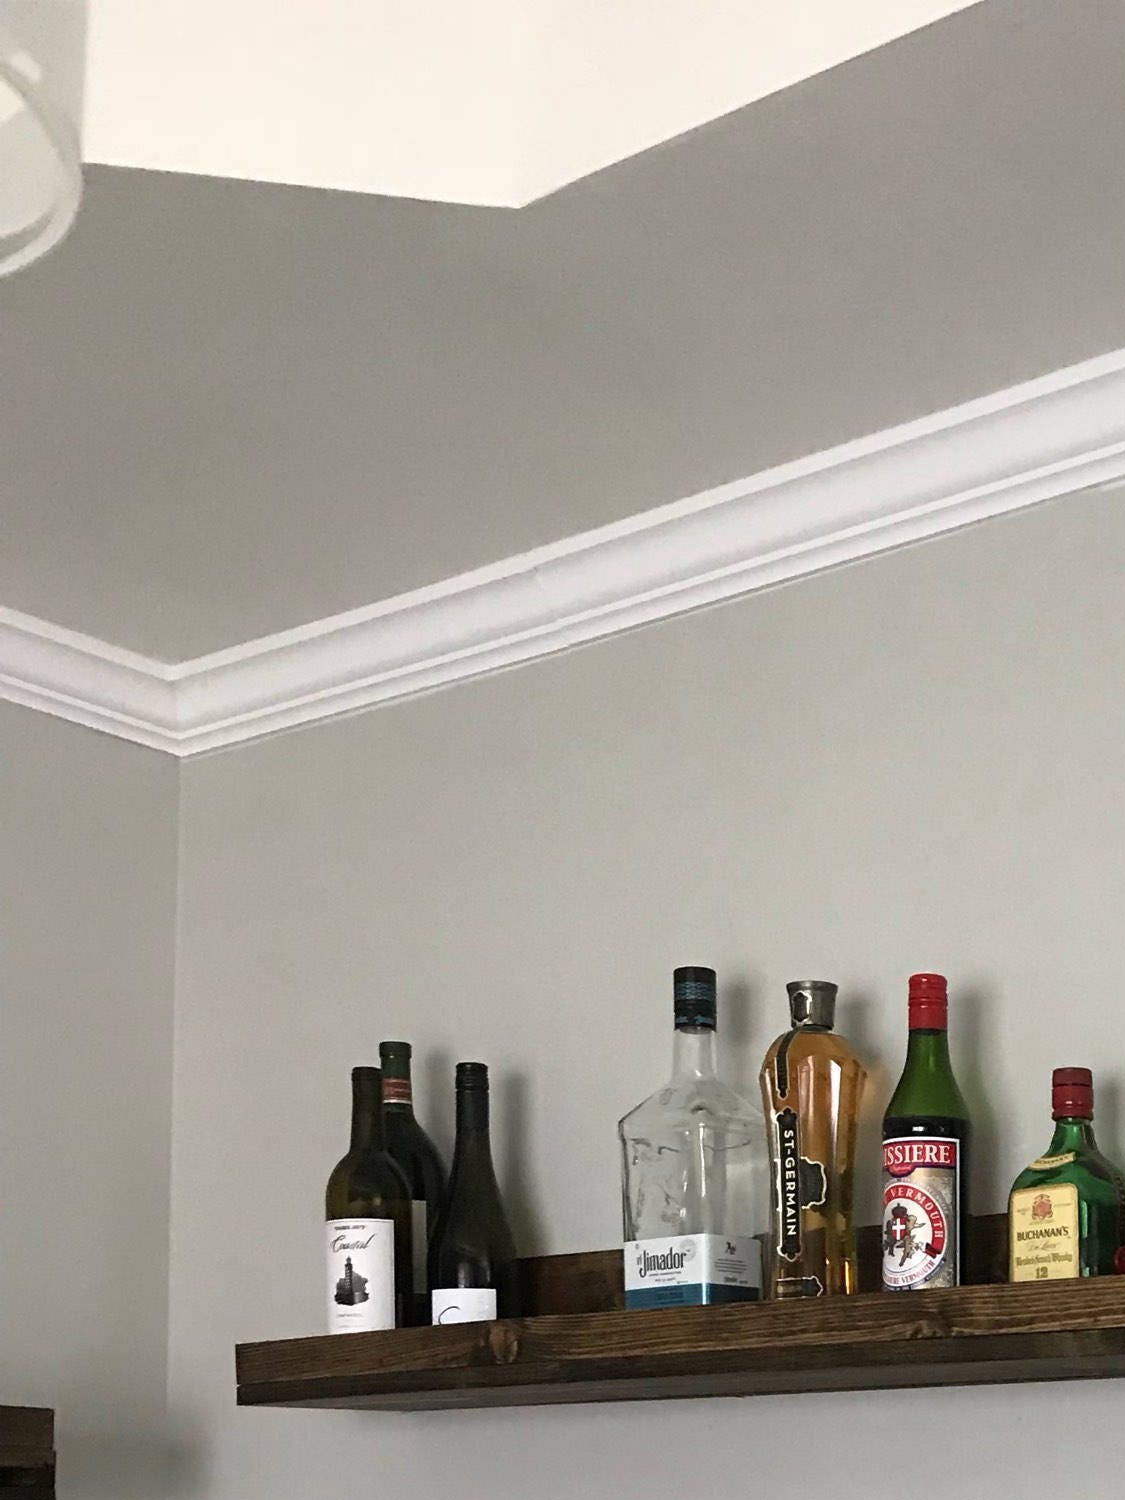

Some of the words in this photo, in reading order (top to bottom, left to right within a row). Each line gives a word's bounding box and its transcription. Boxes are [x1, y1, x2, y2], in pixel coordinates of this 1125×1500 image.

[784, 1129, 798, 1236] ST-GERMAIN
[890, 1187, 944, 1239] VERMOUTH
[1017, 1225, 1069, 1241] BUCHANAN'S
[639, 1247, 687, 1278] Jimador
[1035, 1266, 1049, 1279] 12
